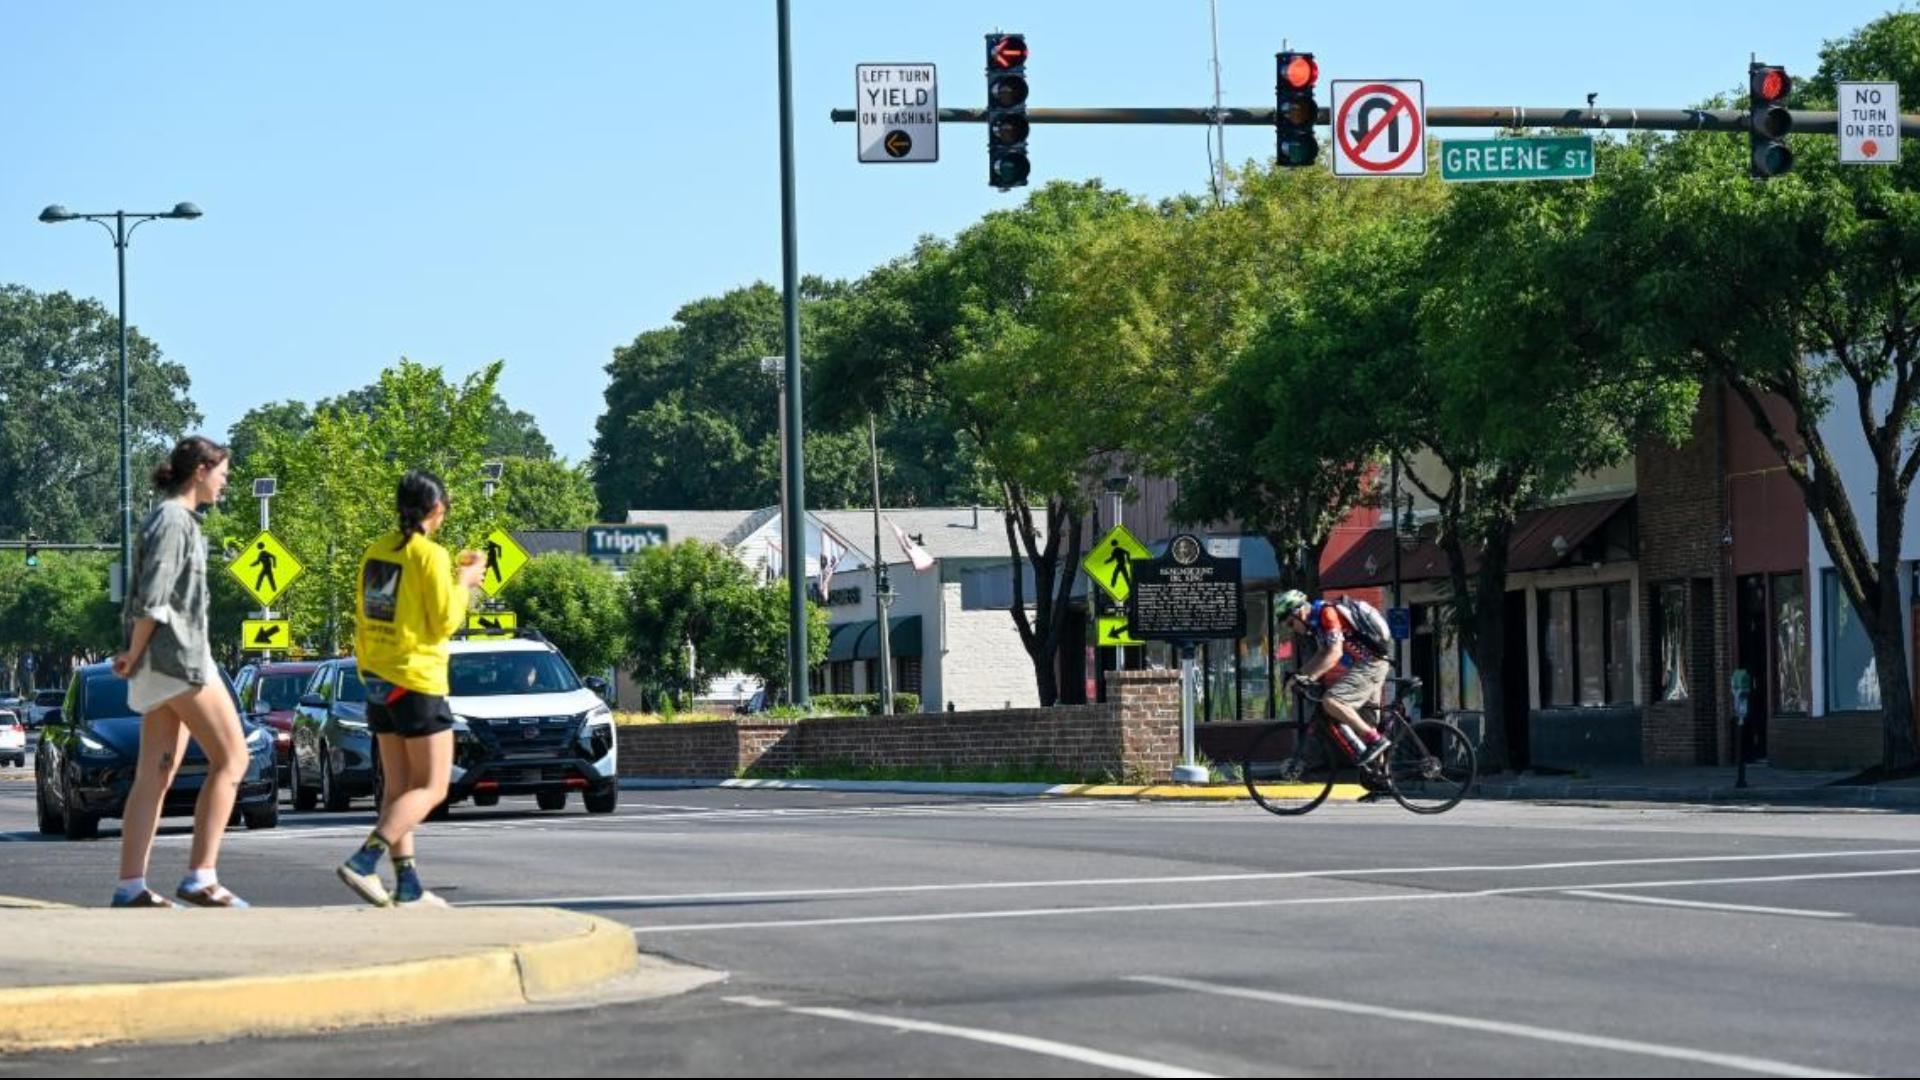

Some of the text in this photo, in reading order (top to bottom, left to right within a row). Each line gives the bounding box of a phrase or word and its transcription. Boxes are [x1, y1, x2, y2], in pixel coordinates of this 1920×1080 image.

[862, 70, 930, 83] LEFT TURN
[867, 87, 928, 106] YIELD
[1856, 88, 1881, 104] NO
[862, 111, 933, 125] ON FLASHING
[1851, 108, 1887, 121] TURN
[1845, 124, 1895, 137] ON RED
[1446, 146, 1587, 173] GREENE ST
[593, 529, 662, 554] Tripp's
